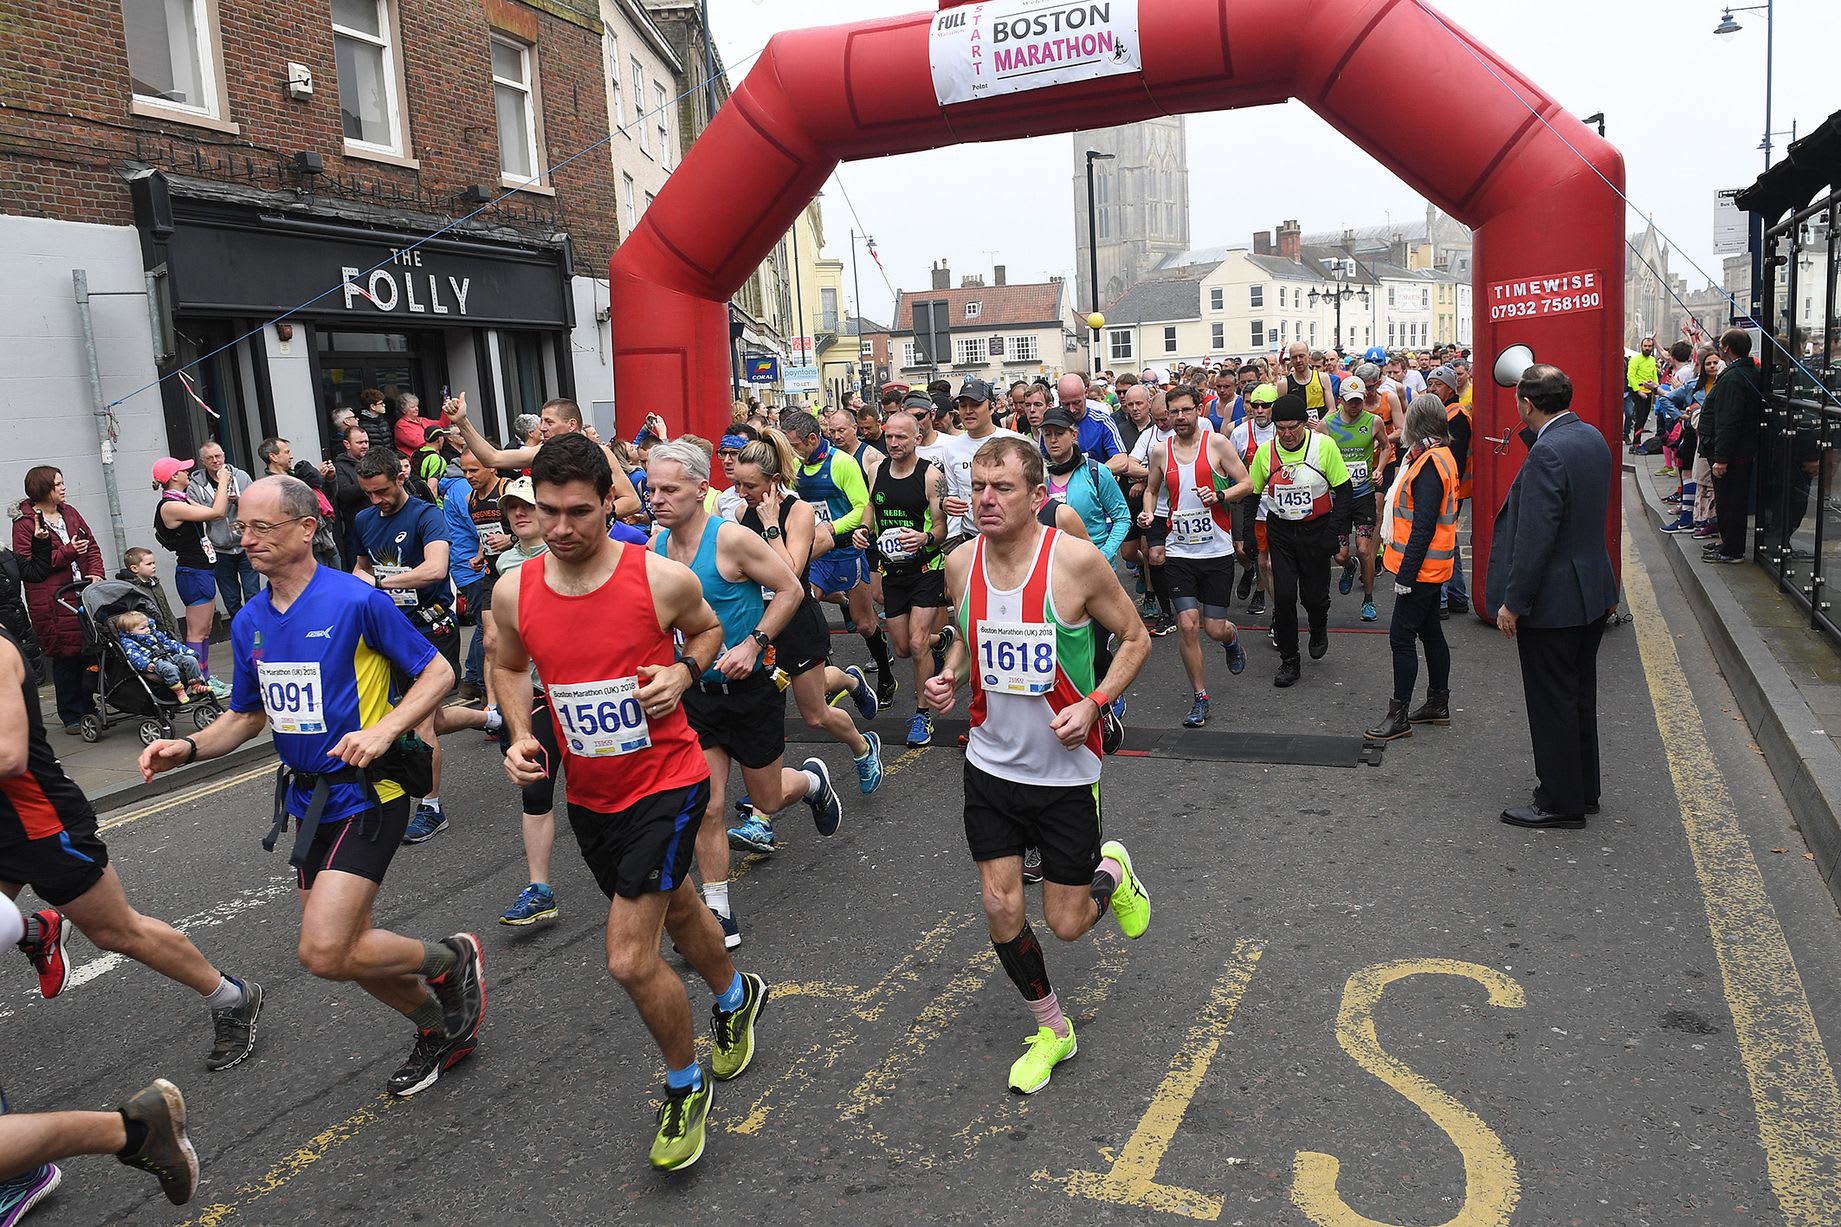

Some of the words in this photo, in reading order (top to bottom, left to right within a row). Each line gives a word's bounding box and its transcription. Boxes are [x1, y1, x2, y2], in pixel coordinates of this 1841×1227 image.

[937, 12, 966, 31] FULL
[994, 2, 1110, 43] BOSTON
[971, 5, 983, 75] START
[994, 31, 1113, 72] MARATHON
[972, 83, 988, 91] Point
[389, 248, 422, 267] THE
[342, 266, 470, 315] FOLLY
[1494, 273, 1594, 299] TIMEWISE
[1491, 301, 1536, 318] 07932
[1541, 293, 1599, 312] 758190
[784, 368, 817, 378] poyntons
[1276, 491, 1311, 506] 1453
[883, 509, 907, 517] REBEL
[880, 519, 914, 527] RUNNERS
[1173, 517, 1212, 534] 1138
[980, 626, 997, 634] Boston
[998, 628, 1023, 636] Marathon
[1024, 629, 1038, 637] (UK)
[981, 640, 1053, 673] 1618
[303, 668, 317, 676] 2018
[553, 690, 573, 698] Boston
[573, 688, 603, 697] Marathon
[604, 686, 619, 695] (UK)
[620, 682, 636, 692] 2018
[559, 697, 642, 736] 1560
